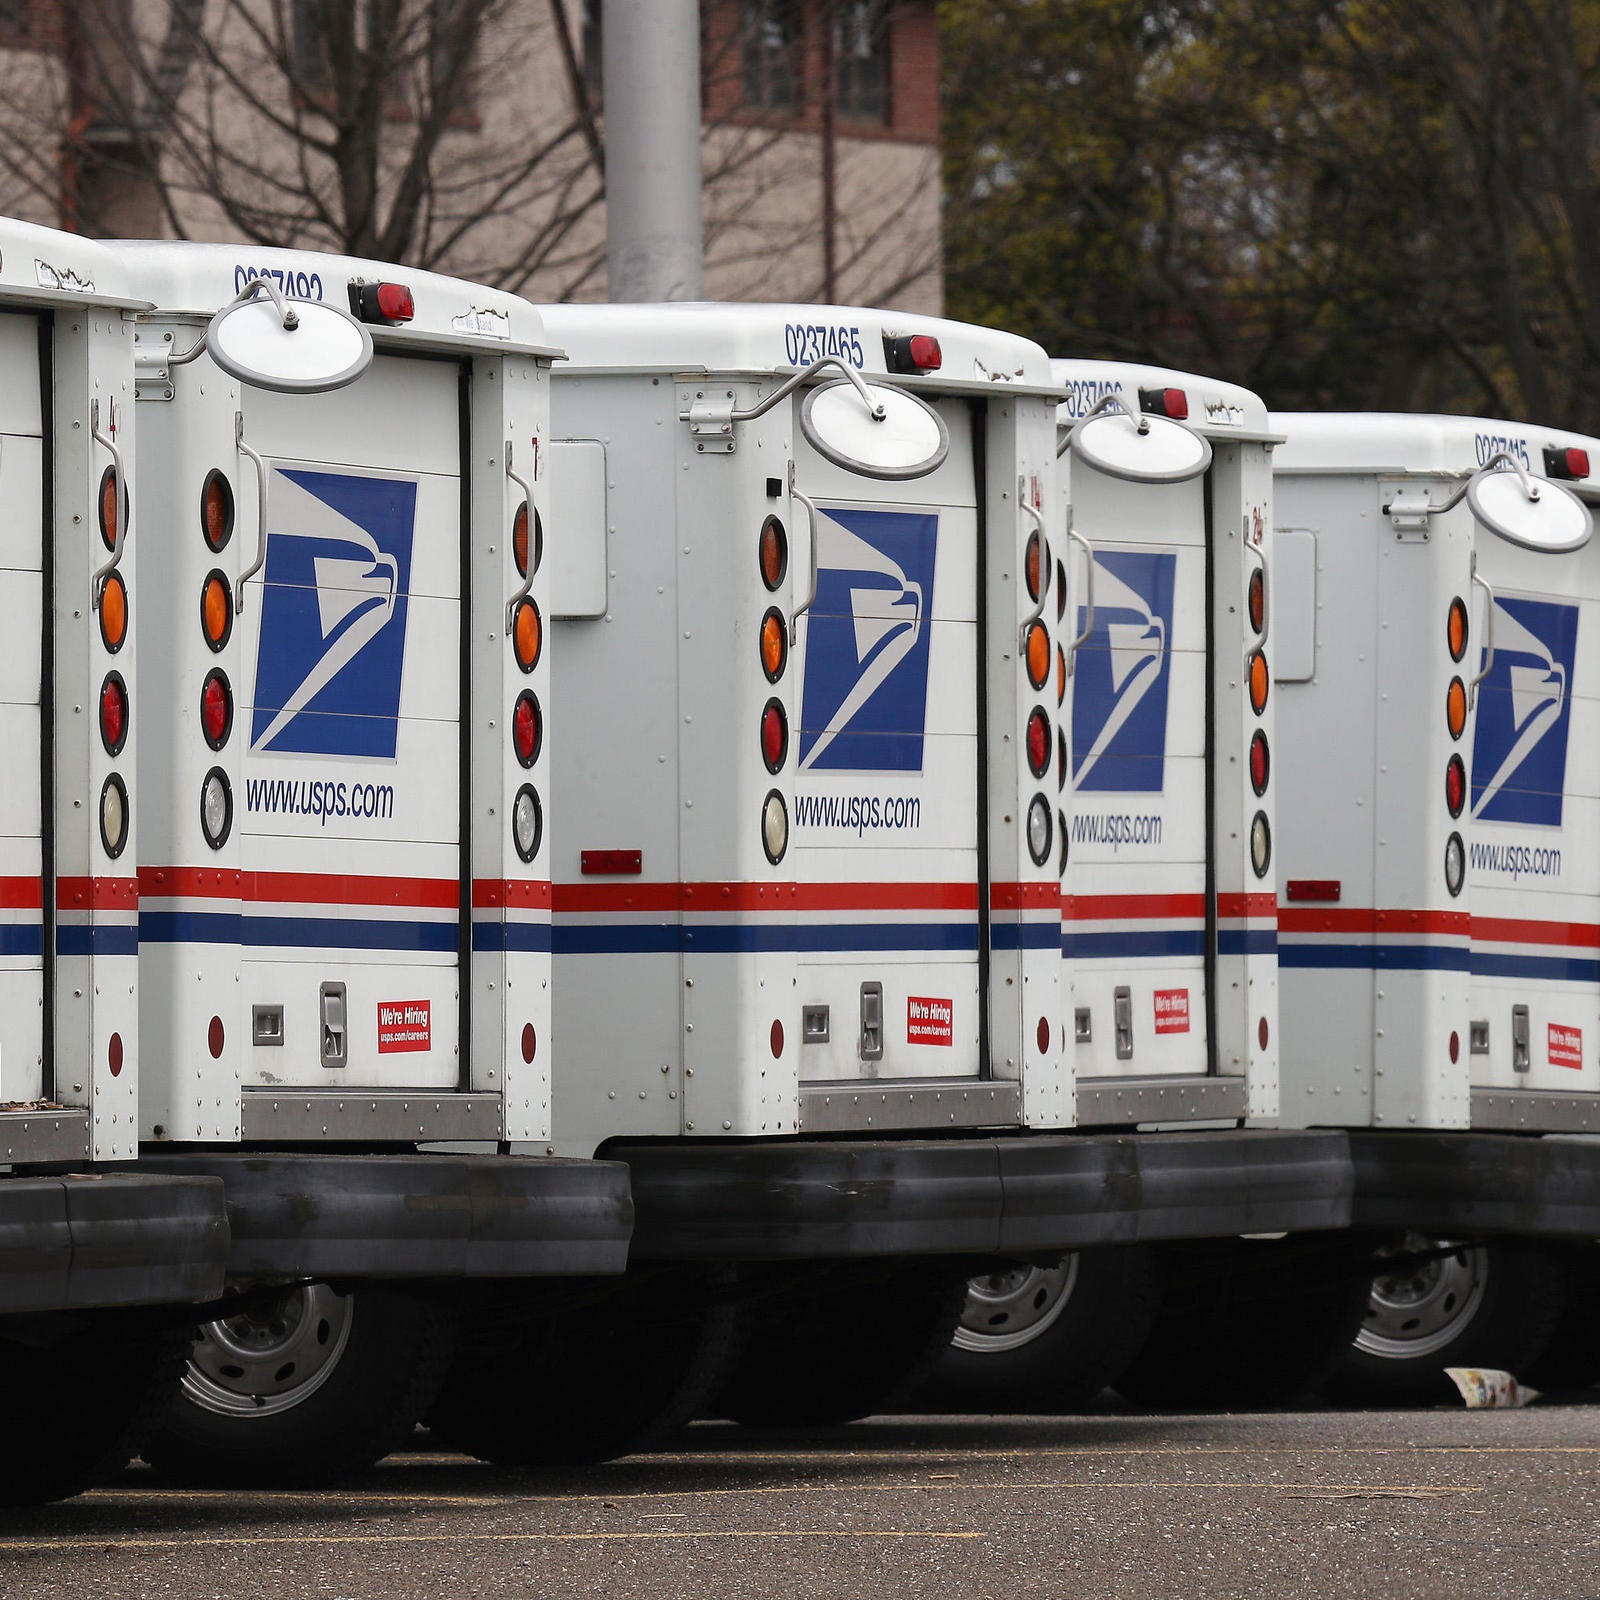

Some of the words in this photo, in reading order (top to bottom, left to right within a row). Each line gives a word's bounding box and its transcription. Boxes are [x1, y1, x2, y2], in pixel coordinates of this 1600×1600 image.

[234, 265, 323, 302] 027492
[785, 324, 864, 370] 0237465
[246, 778, 394, 826] www.usps.com
[794, 795, 921, 838] www.usps.com
[1072, 814, 1162, 851] ww.usps.com
[380, 1007, 403, 1026] We're
[404, 1005, 428, 1028] Hiring
[909, 1001, 929, 1019] We're
[929, 1003, 951, 1025] Hiring
